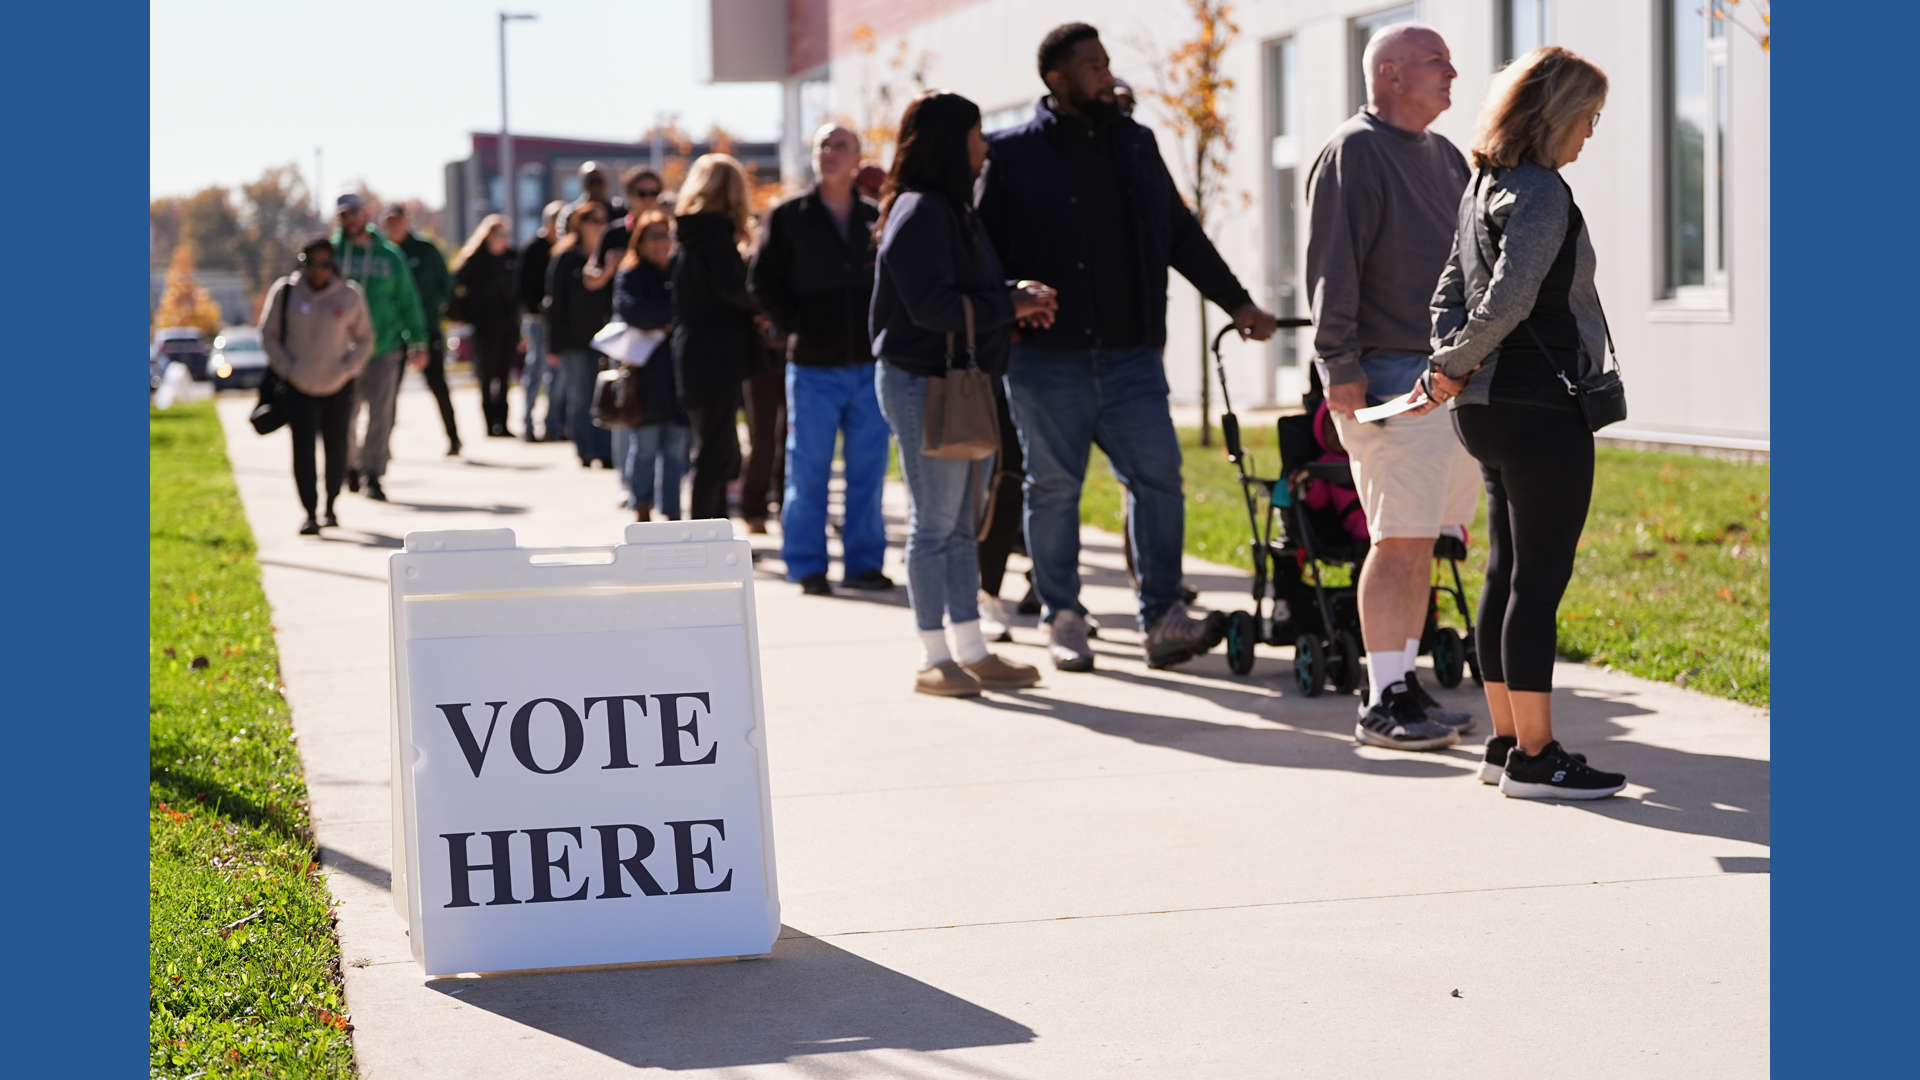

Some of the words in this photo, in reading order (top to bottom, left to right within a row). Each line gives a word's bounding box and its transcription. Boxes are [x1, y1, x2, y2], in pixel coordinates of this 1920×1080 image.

[436, 692, 718, 778] VOTE
[1551, 770, 1567, 782] S
[439, 819, 733, 908] HERE
